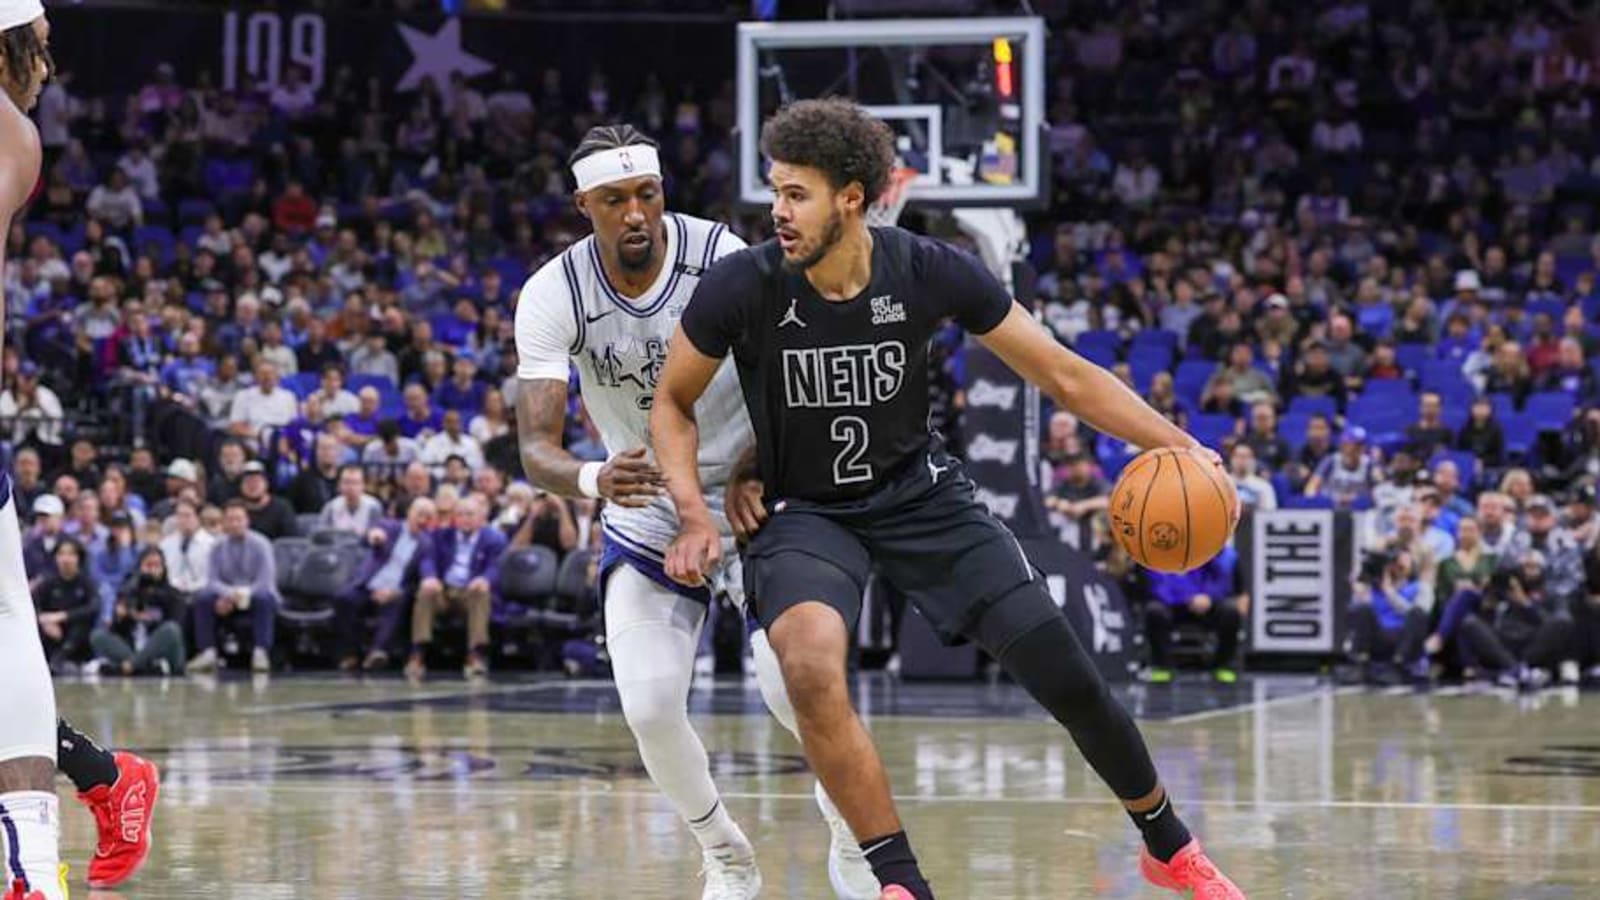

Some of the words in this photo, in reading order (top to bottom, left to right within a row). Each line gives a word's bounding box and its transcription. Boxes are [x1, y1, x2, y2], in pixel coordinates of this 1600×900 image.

[223, 12, 326, 92] 109
[871, 295, 891, 305] GET
[872, 302, 903, 314] YOUR
[872, 312, 905, 324] GUIDE
[783, 340, 906, 408] NETS
[830, 415, 873, 485] 2
[1265, 522, 1321, 583] THE
[1265, 594, 1321, 638] ON
